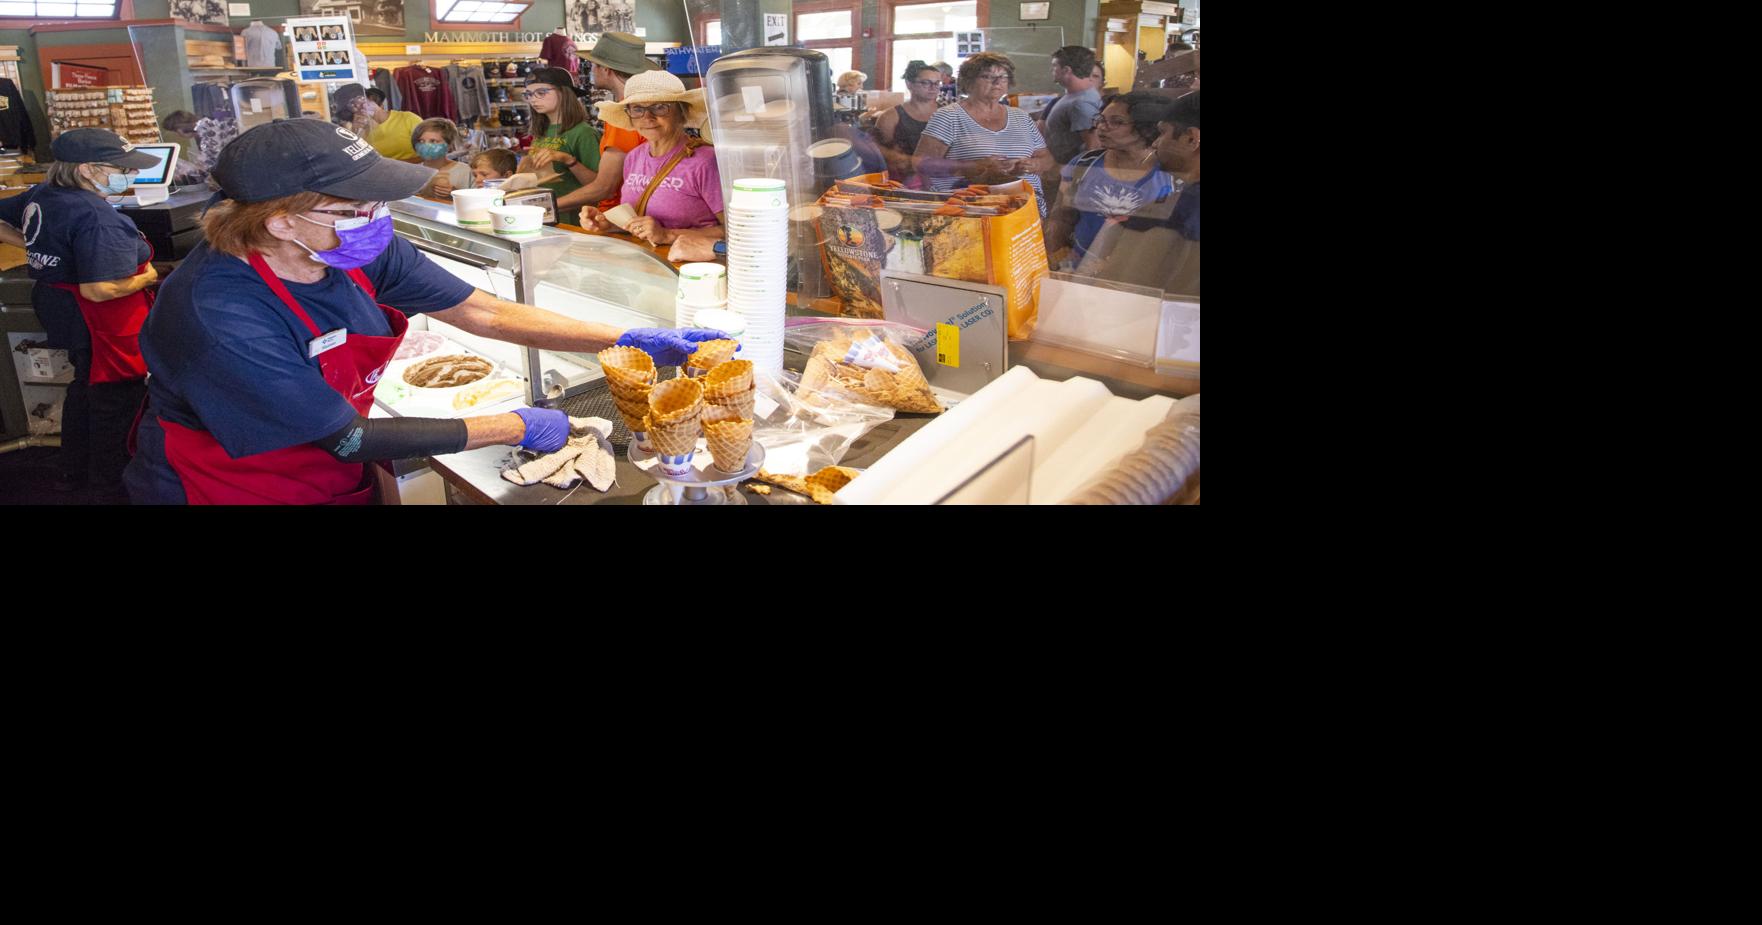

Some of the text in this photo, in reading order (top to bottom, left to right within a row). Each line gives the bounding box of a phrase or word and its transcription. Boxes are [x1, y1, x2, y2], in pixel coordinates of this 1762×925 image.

[766, 15, 786, 27] EXIT
[424, 31, 510, 43] MAMMOTH
[514, 32, 543, 43] HOT
[956, 302, 988, 321] Solution
